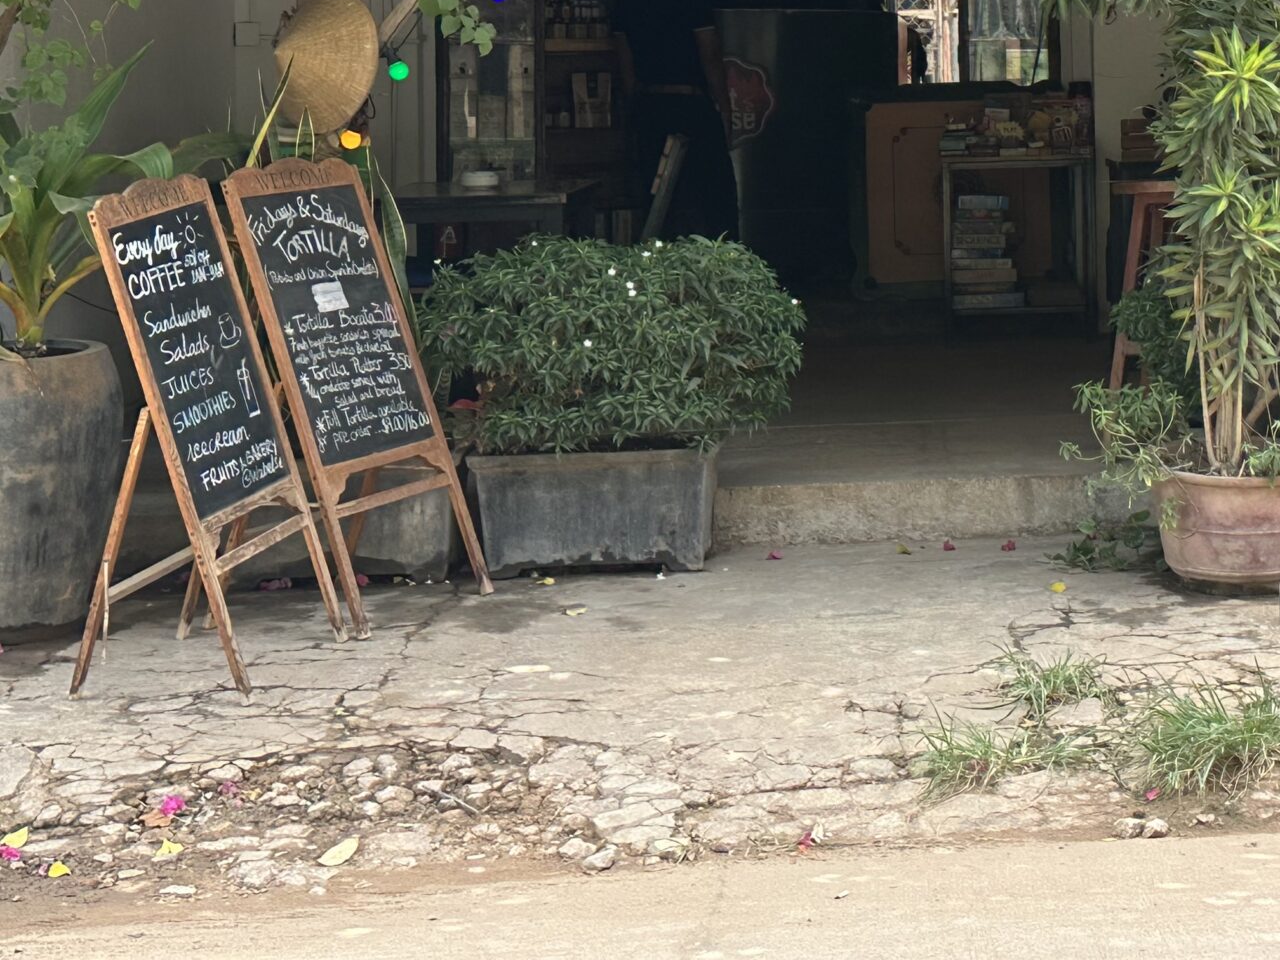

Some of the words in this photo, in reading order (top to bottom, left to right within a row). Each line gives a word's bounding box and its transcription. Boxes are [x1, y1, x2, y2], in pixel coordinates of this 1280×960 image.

[255, 167, 333, 191] WELCOME
[247, 202, 298, 246] Fridays
[296, 196, 312, 218] &
[128, 260, 186, 300] COFFEE
[144, 297, 212, 338] Sandwiches
[161, 366, 214, 399] JUICES
[173, 391, 237, 434] SMOOTHIES
[200, 459, 240, 491] FRUITS
